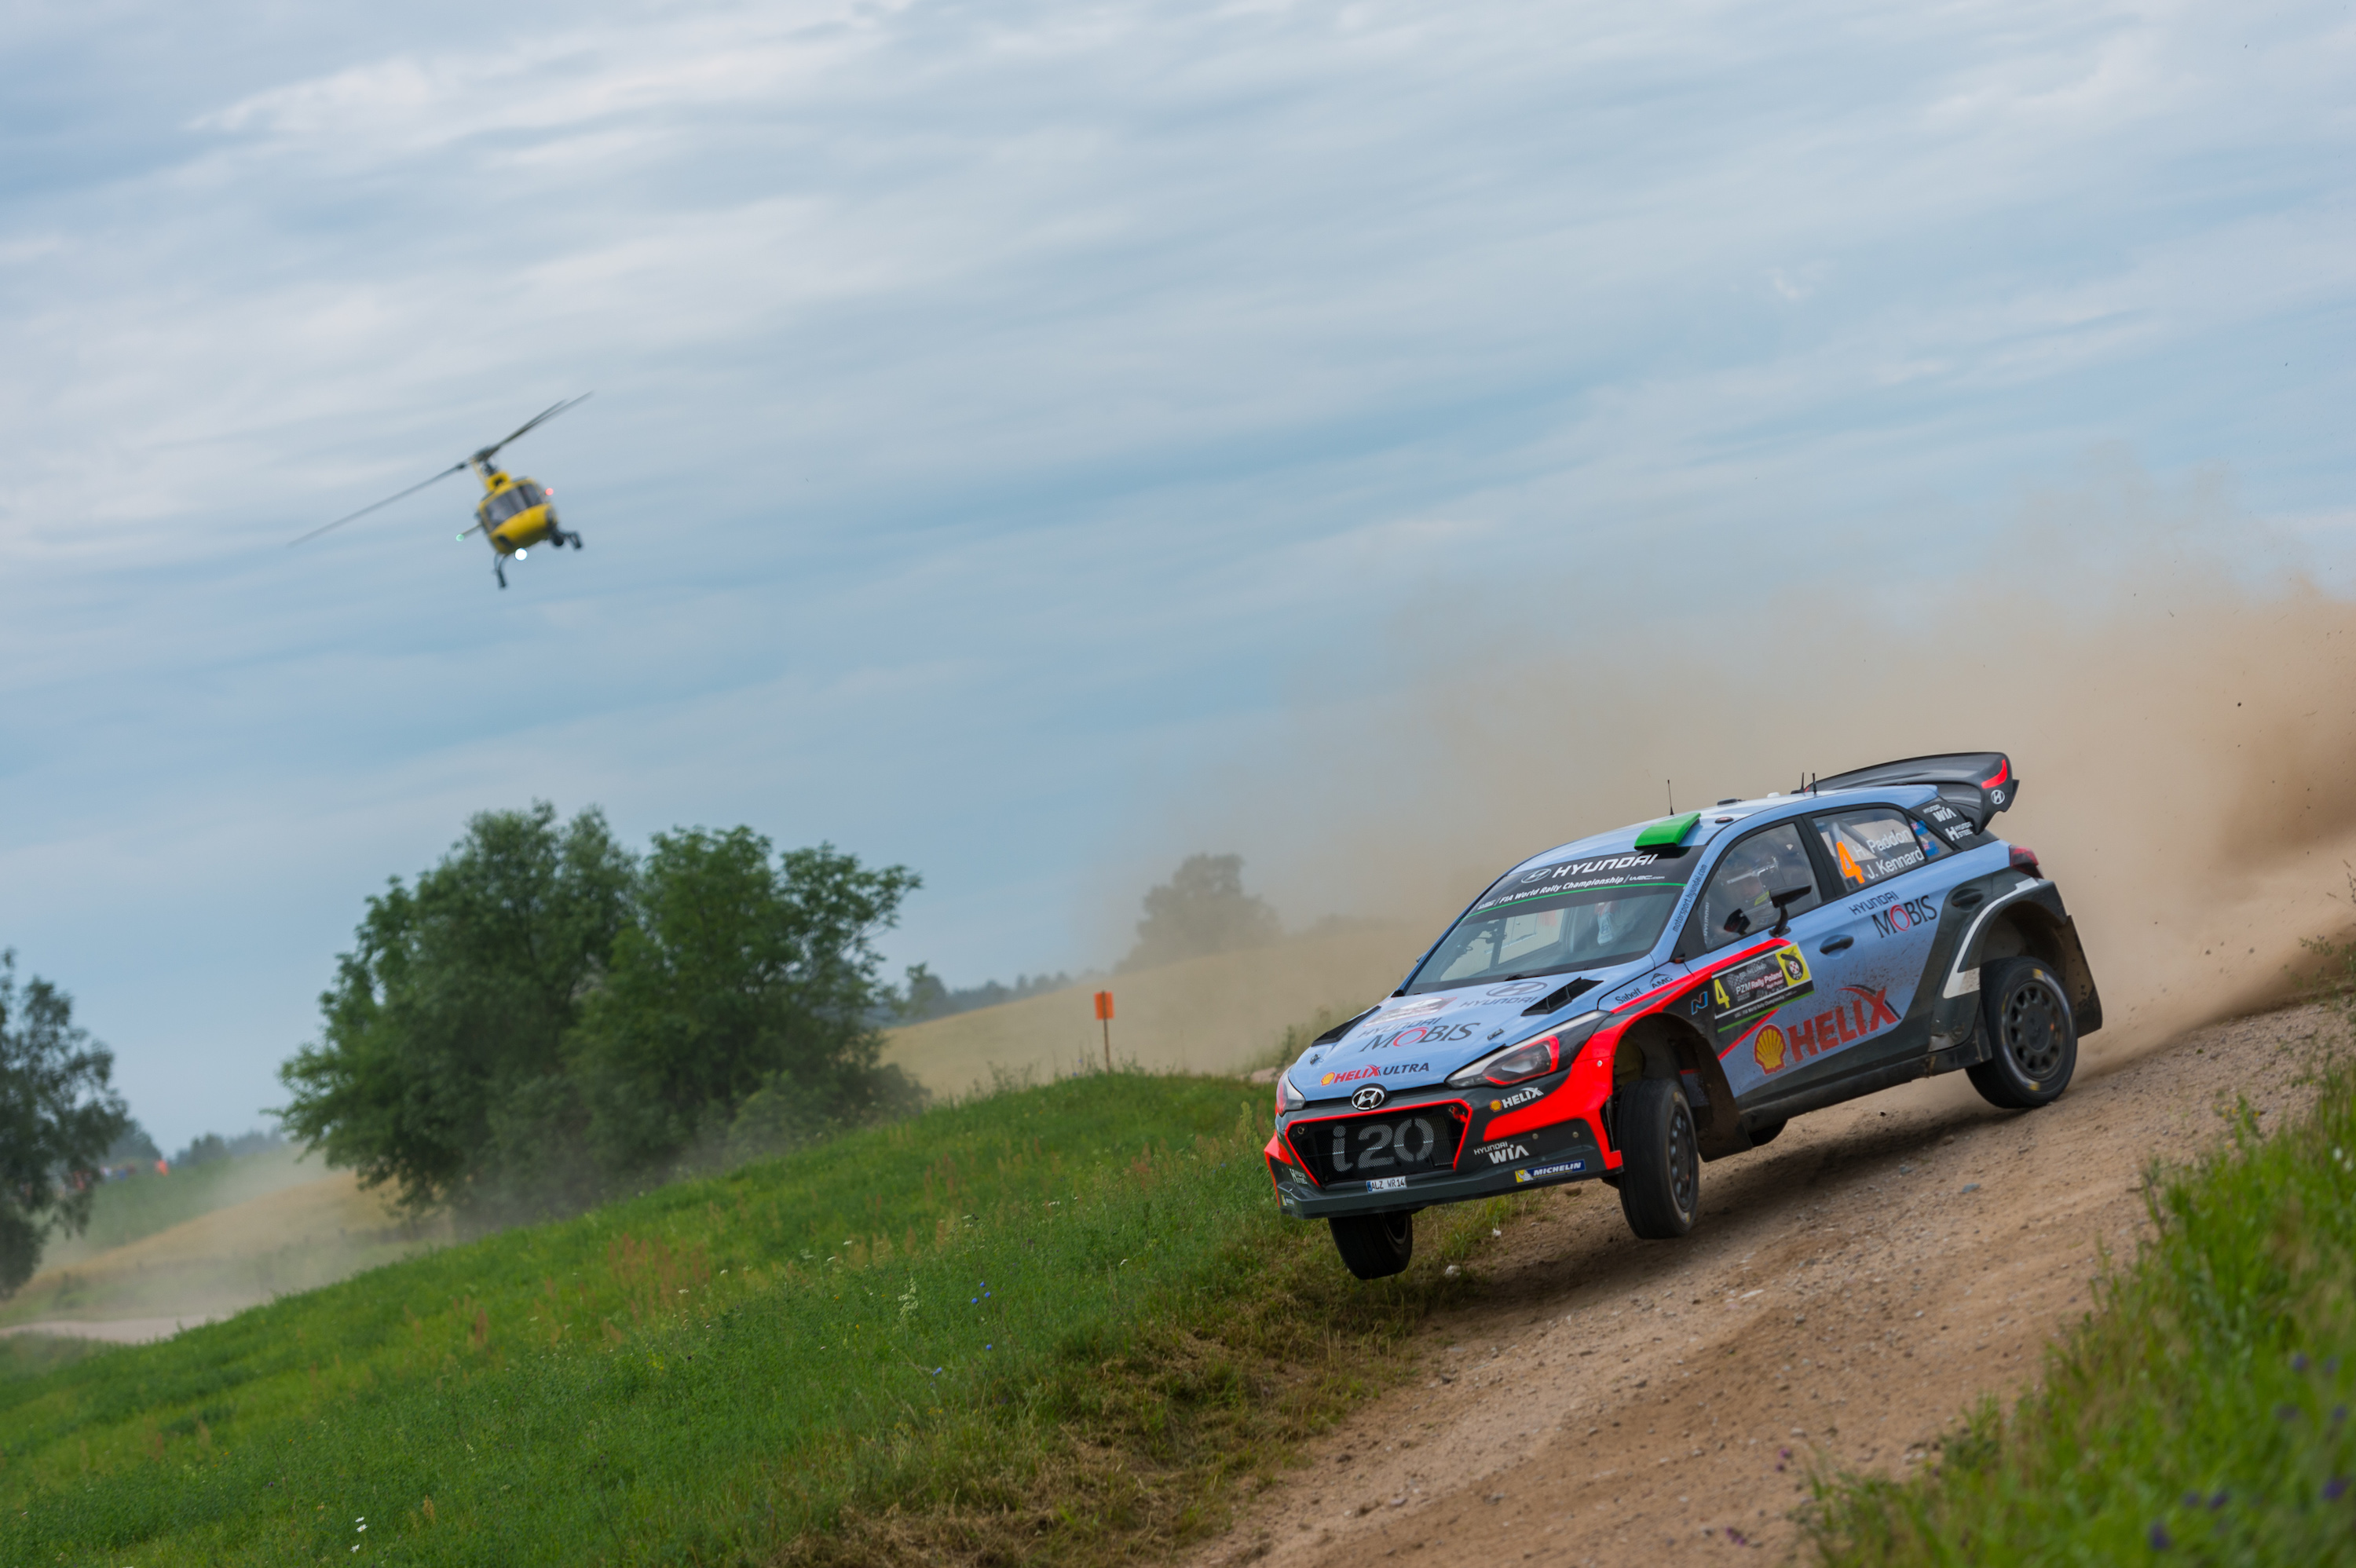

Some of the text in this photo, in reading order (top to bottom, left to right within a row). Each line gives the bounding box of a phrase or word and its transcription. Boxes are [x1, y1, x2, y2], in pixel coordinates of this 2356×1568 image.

[1852, 829, 1913, 858] H. Paddon
[1552, 853, 1659, 878] HYUNDAI
[1836, 841, 1865, 884] 4
[1867, 847, 1925, 879] J. Kennard
[1499, 894, 1513, 904] FIA
[1515, 888, 1540, 900] World
[1539, 883, 1562, 894] Rally
[1562, 875, 1624, 890] Championship
[1672, 864, 1707, 933] motorsport.hyundai.com
[1849, 890, 1900, 916] HYUNDAI
[1871, 895, 1937, 938] MOBIS
[1714, 978, 1730, 1009] 4
[1736, 981, 1751, 995] PZM
[1751, 978, 1765, 989] Rally
[1764, 970, 1783, 984] Poland
[1459, 996, 1538, 1008] HYUNDAI
[1615, 988, 1643, 1005] Sabelt
[1358, 1017, 1443, 1039] HYUNDAI
[1787, 984, 1901, 1063] HELIX
[1359, 1022, 1482, 1052] MOBIS
[1333, 1062, 1429, 1084] HELIX ULTRA
[1502, 1087, 1545, 1109] HELIX
[1333, 1118, 1435, 1172] i20
[1473, 1142, 1509, 1155] HYUNDAI
[1533, 1162, 1582, 1176] MICHELIN
[1372, 1180, 1385, 1190] ALZ
